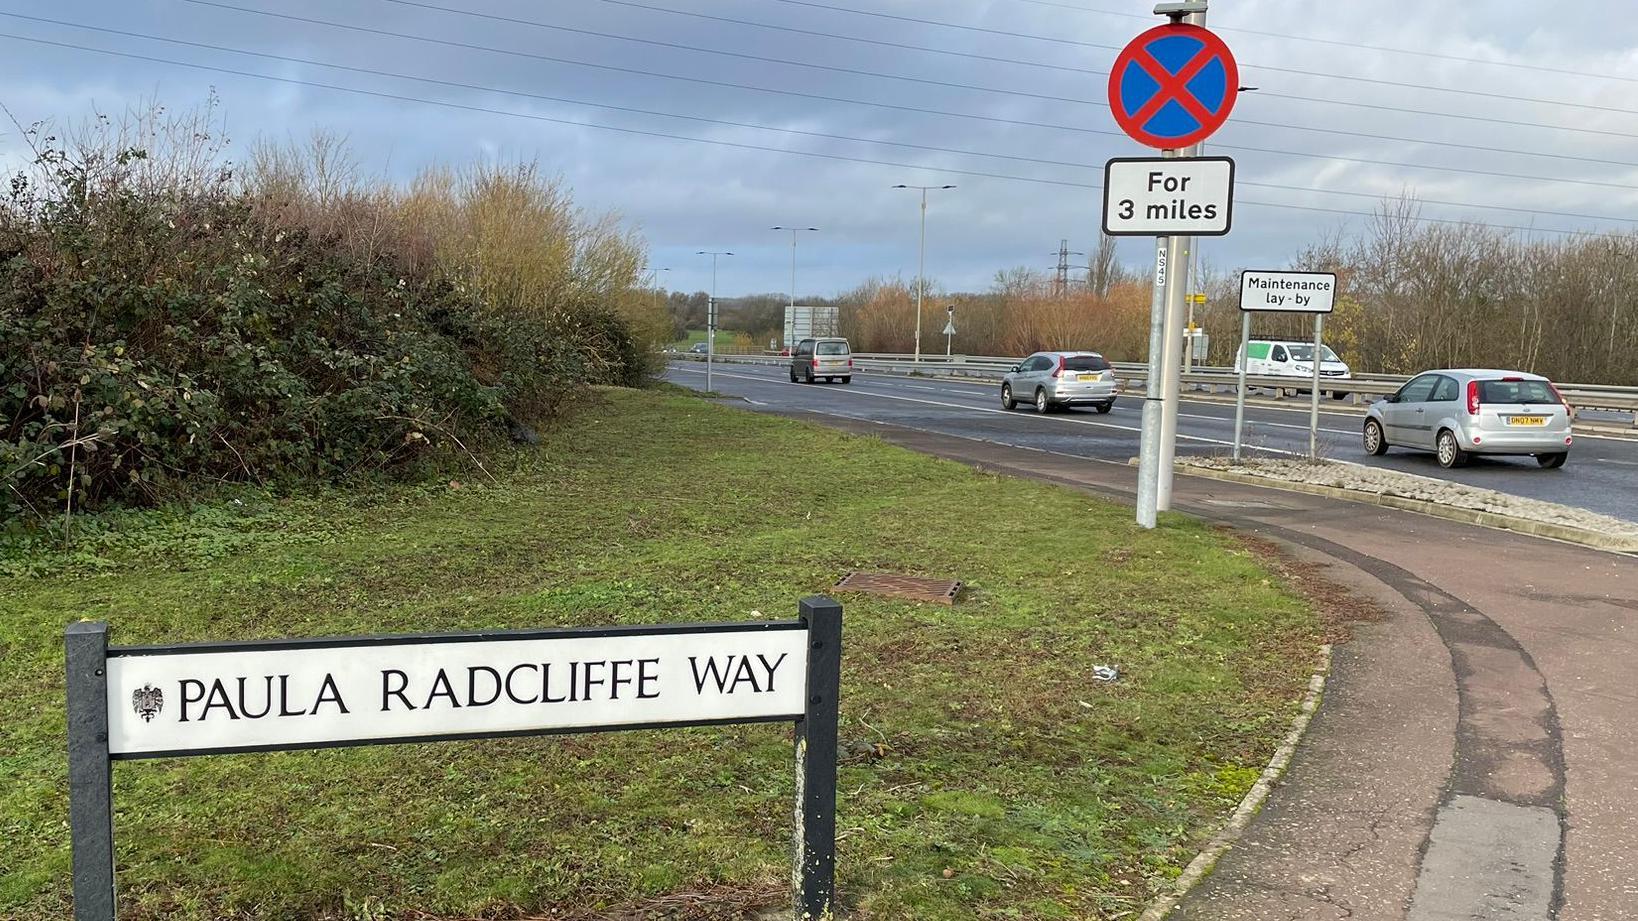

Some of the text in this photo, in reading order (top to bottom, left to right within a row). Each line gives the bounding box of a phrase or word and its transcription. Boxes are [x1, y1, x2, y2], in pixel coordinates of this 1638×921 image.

[1147, 171, 1191, 192] For
[1118, 199, 1217, 220] 3 miles
[1158, 249, 1167, 284] NS45
[1248, 278, 1330, 291] Maintenance
[177, 652, 788, 722] PAULA RADCLIFFE WAY
